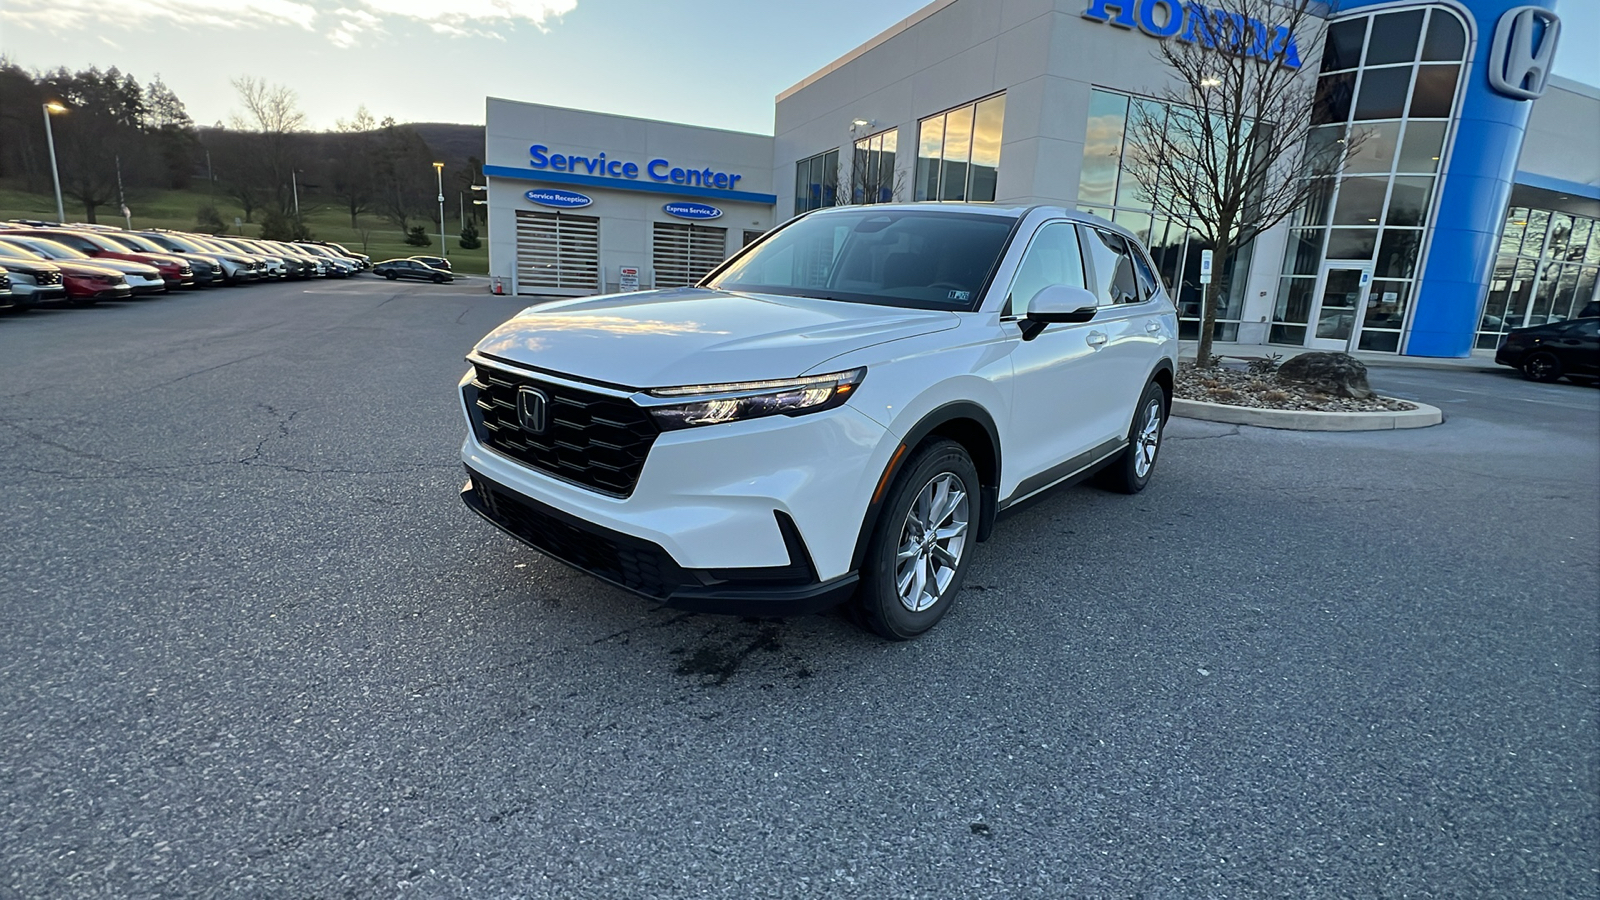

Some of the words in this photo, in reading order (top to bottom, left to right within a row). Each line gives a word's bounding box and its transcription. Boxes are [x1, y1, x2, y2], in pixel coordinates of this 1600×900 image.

[529, 144, 639, 178] Service
[646, 158, 741, 190] Center
[528, 191, 554, 201] Service
[555, 194, 588, 204] Reception
[666, 205, 688, 213] Express
[689, 207, 710, 215] Service
